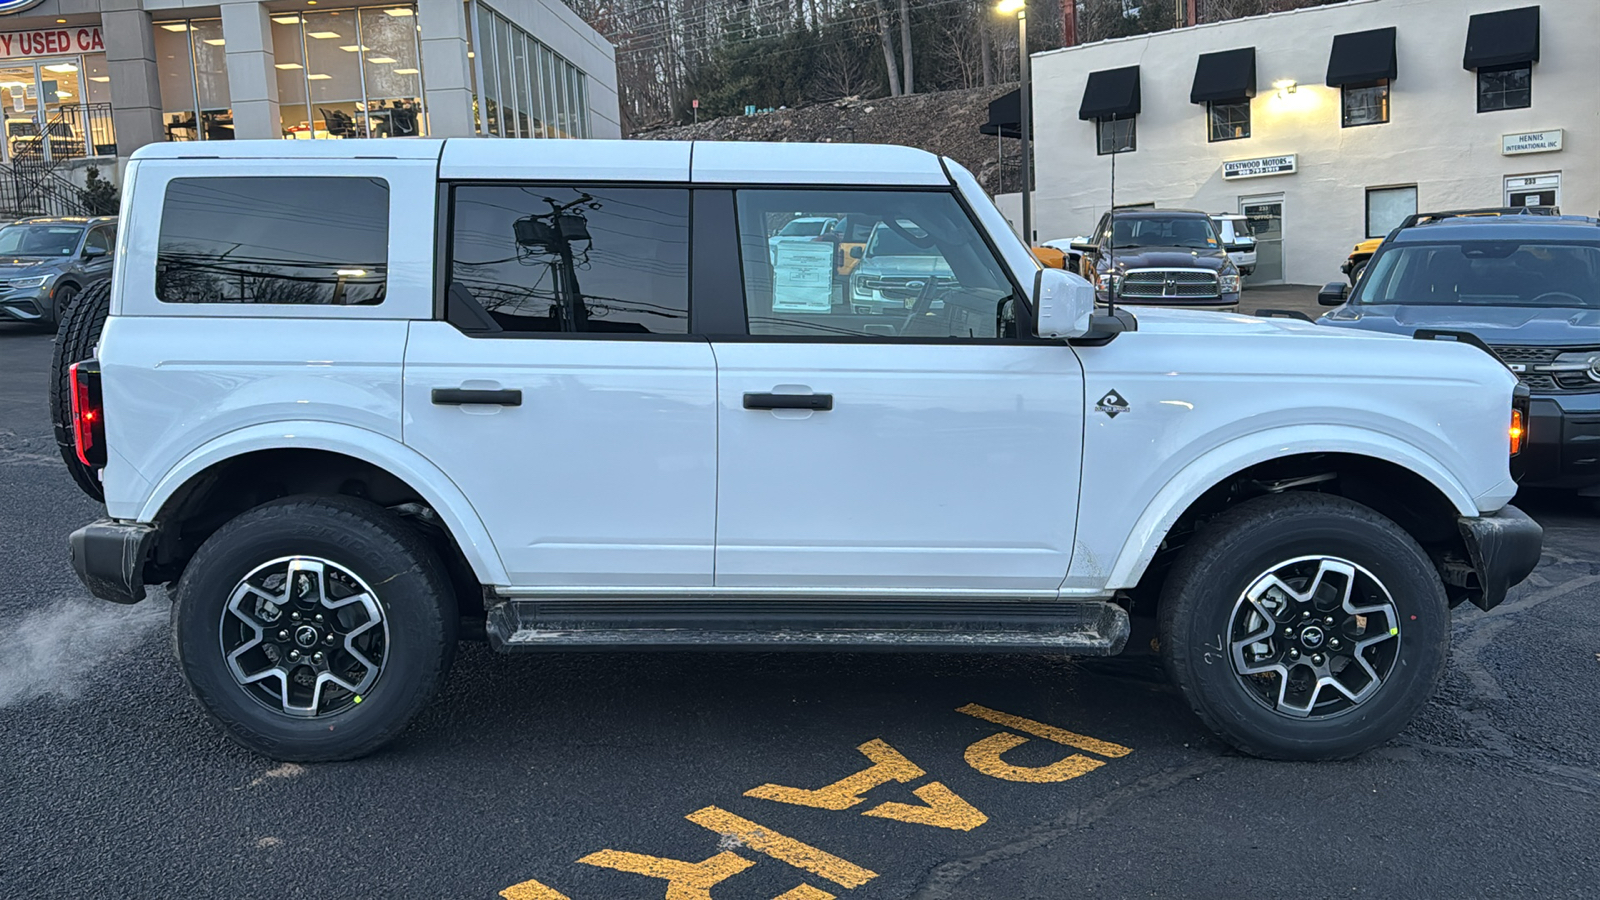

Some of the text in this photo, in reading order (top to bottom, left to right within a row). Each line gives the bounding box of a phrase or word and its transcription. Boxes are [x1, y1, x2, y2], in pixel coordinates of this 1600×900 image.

[0, 28, 105, 56] Y USED CA
[1506, 142, 1547, 151] INTERNATIONAL
[1519, 134, 1544, 142] HENNIS
[498, 702, 1134, 900] PAR
